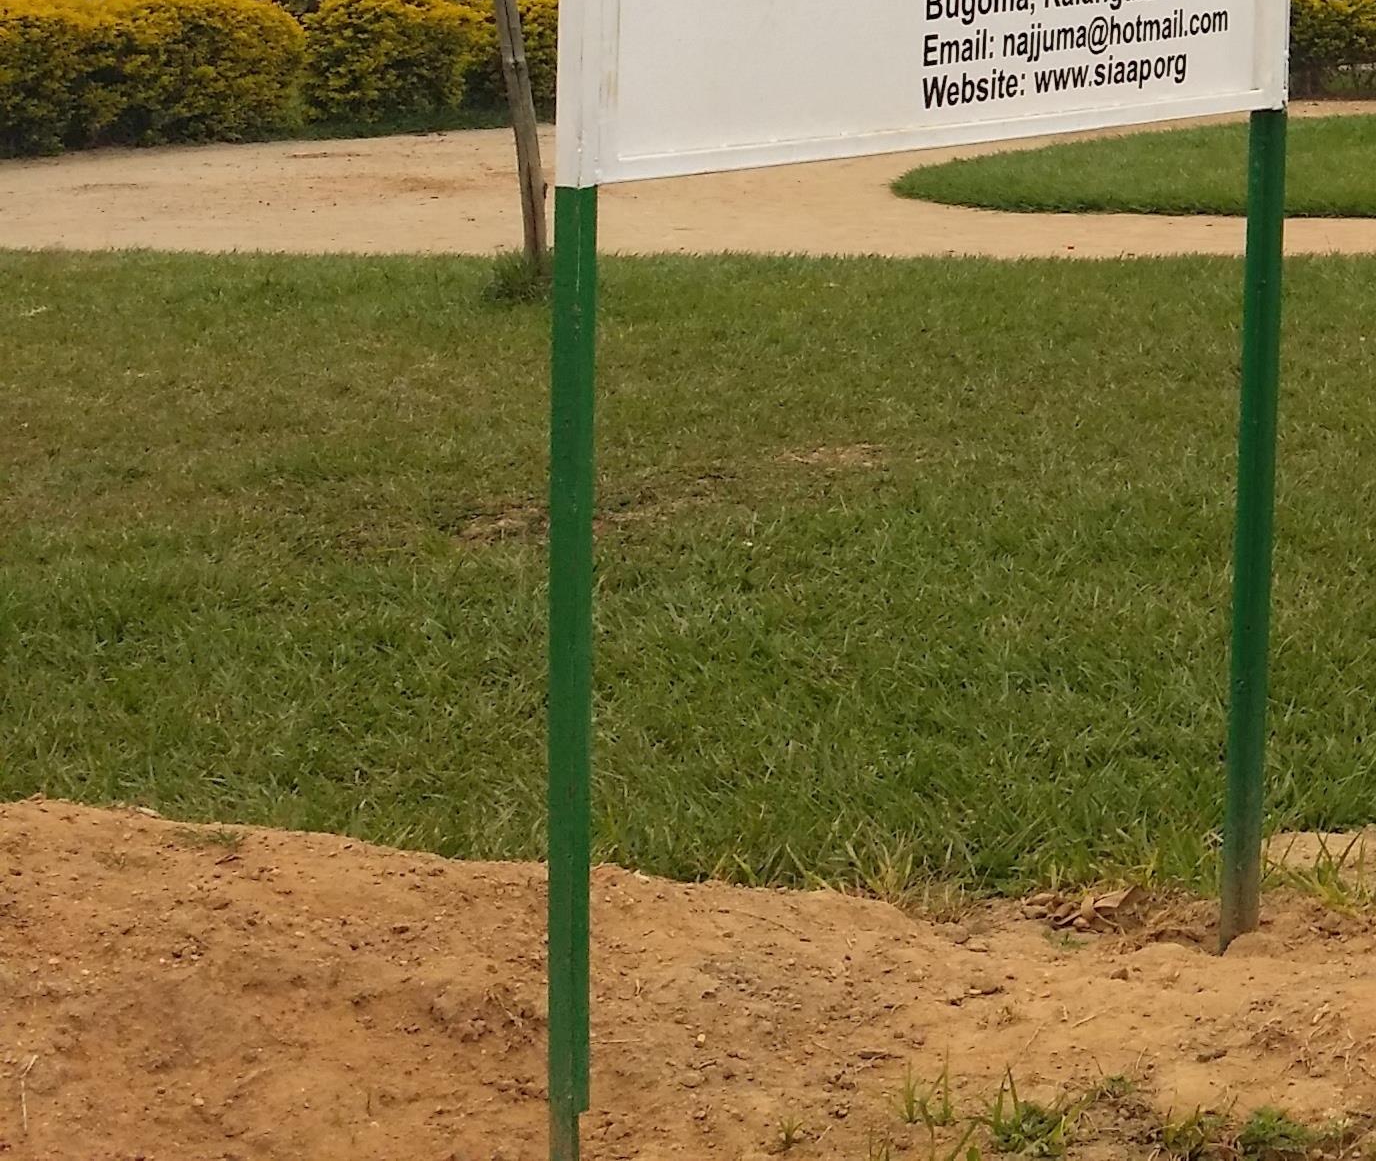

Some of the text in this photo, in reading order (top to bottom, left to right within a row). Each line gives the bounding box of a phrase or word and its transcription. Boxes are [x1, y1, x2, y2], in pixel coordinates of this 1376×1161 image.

[923, 8, 1229, 67] Email: najjuma@hotmail.com
[922, 72, 1026, 110] Website:
